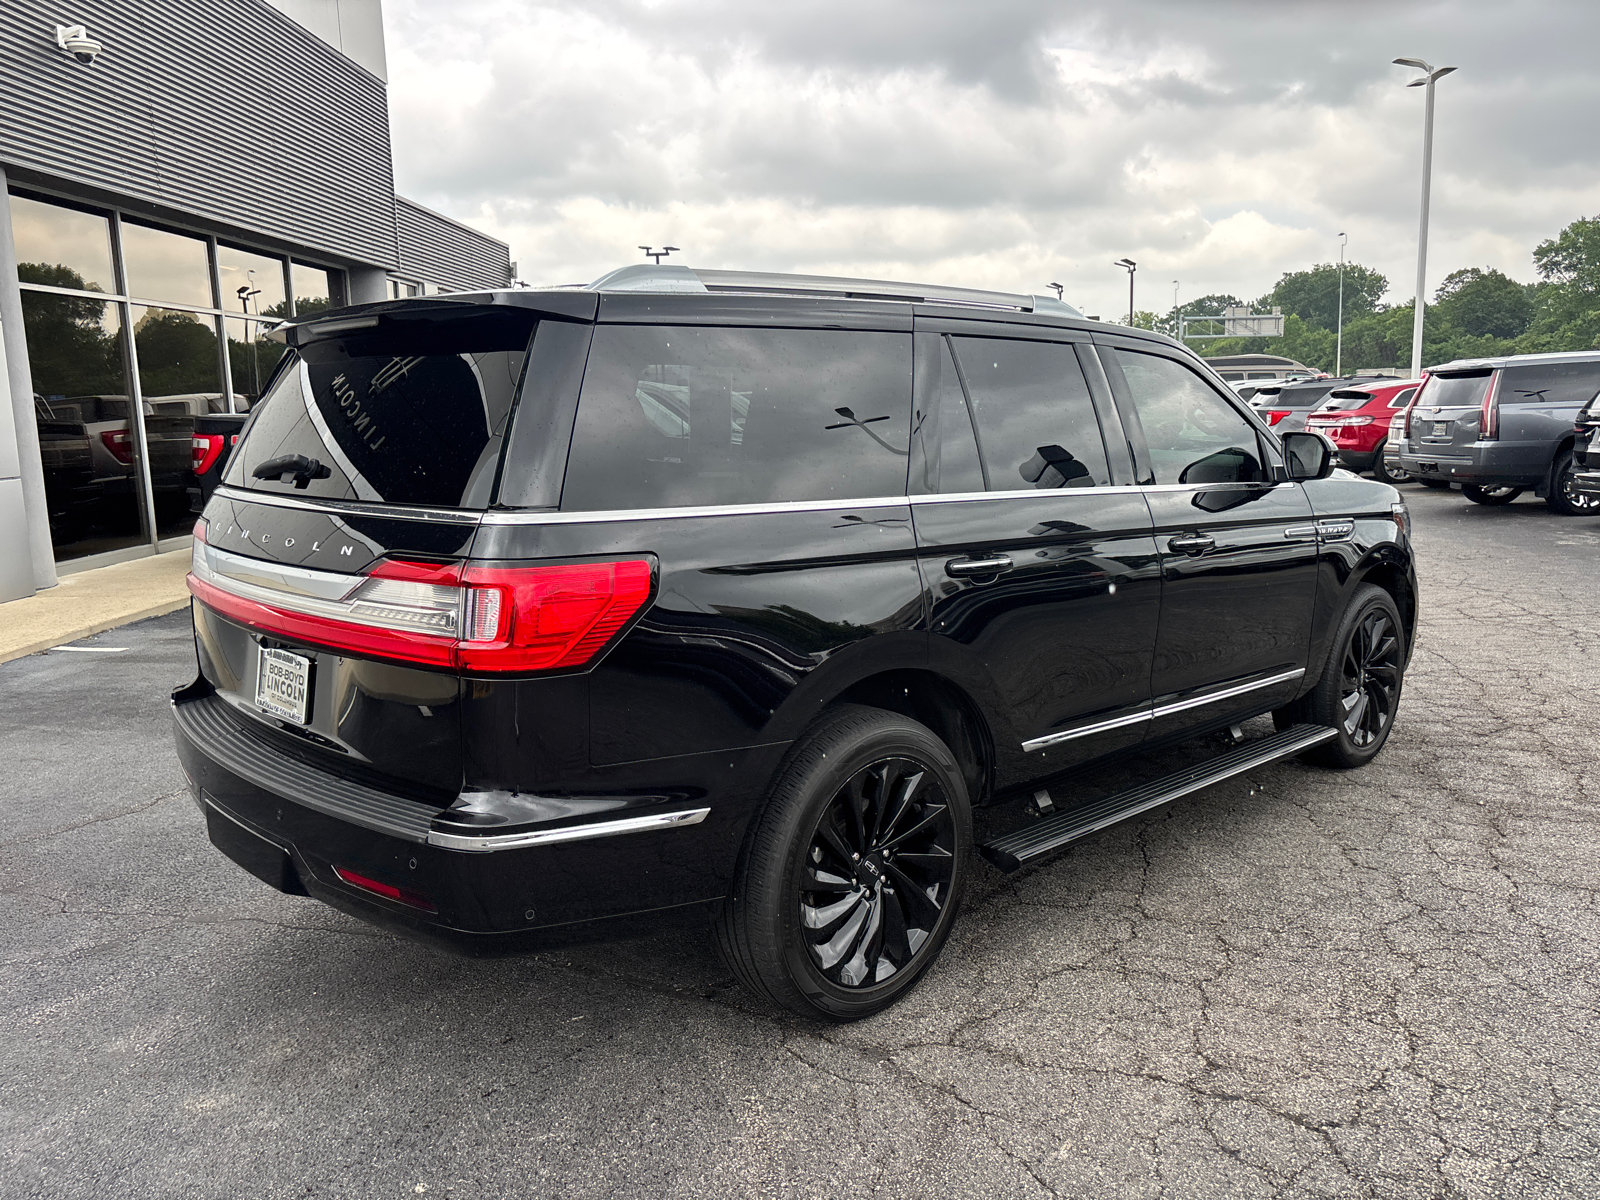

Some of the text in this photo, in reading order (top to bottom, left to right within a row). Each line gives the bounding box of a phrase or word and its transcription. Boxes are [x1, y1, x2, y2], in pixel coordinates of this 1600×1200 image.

[215, 522, 354, 556] LINCOLN
[266, 674, 305, 703] LINCOLN
[268, 663, 305, 686] BOB-BOYD
